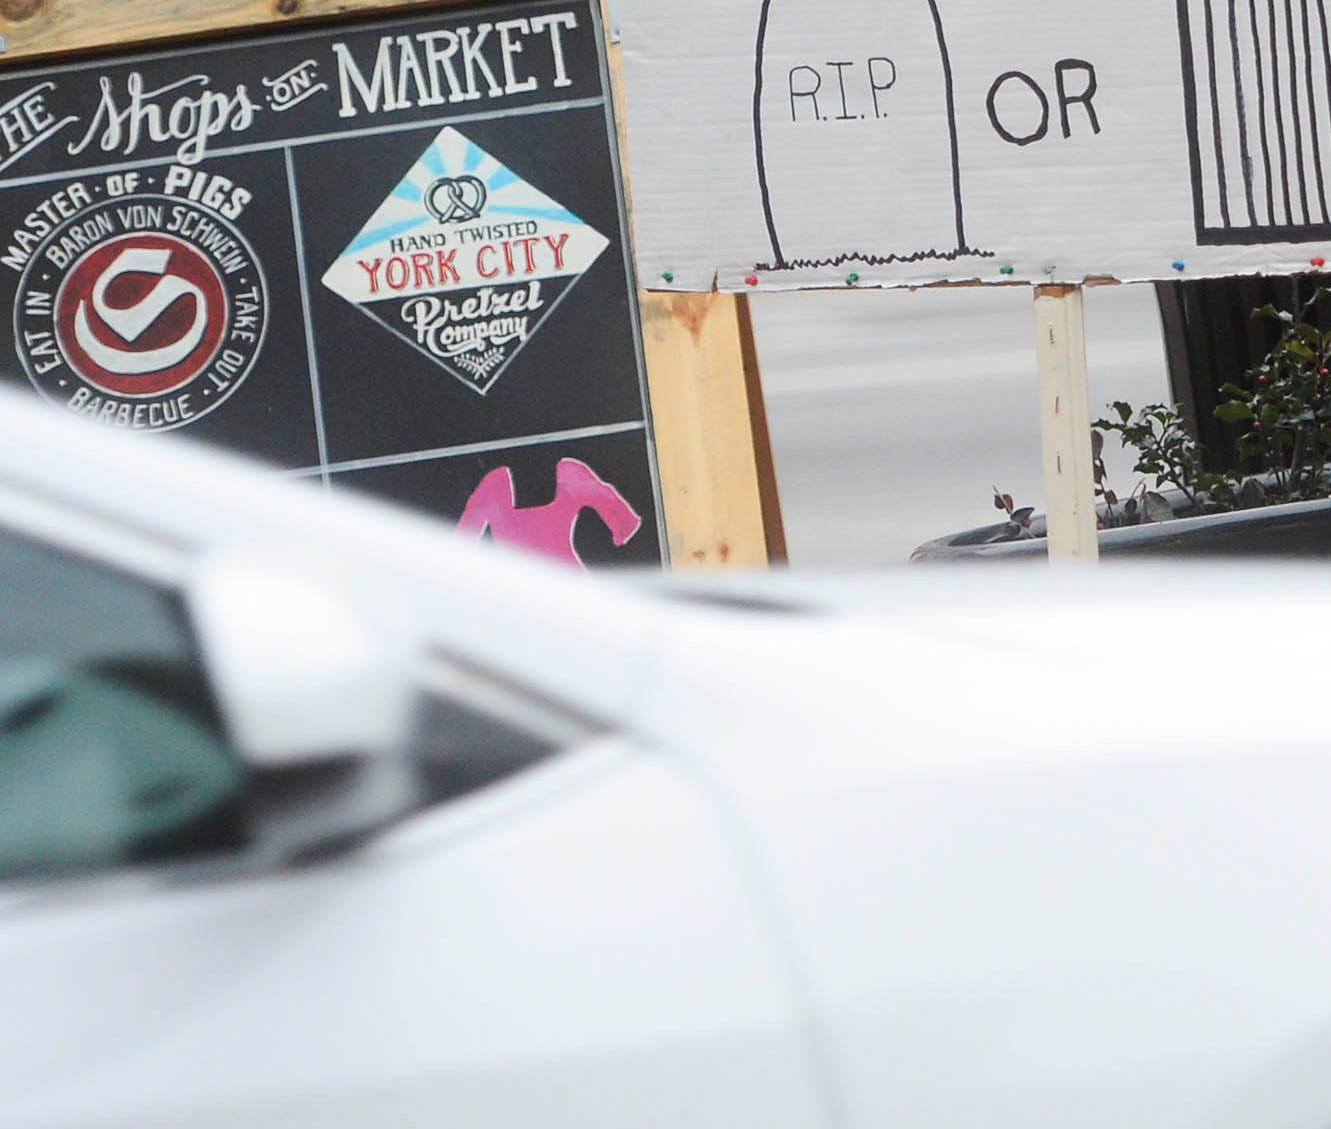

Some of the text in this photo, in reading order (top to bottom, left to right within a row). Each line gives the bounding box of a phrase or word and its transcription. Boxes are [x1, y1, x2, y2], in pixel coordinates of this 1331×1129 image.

[0, 94, 54, 161] HE
[67, 72, 263, 166] Shops
[332, 10, 578, 119] MARKET
[986, 58, 1102, 146] OR
[0, 165, 253, 272] MASTER OF PIGS
[45, 205, 249, 275] BARON VON SCHWEIN
[389, 220, 538, 254] HAND TWISTED
[357, 232, 570, 295] YORK CITY
[24, 290, 64, 375] EAT IN
[207, 286, 260, 392] TAKE OUT
[400, 280, 545, 344] Pretzel
[426, 315, 530, 358] Company
[67, 386, 194, 427] BARBECUE
